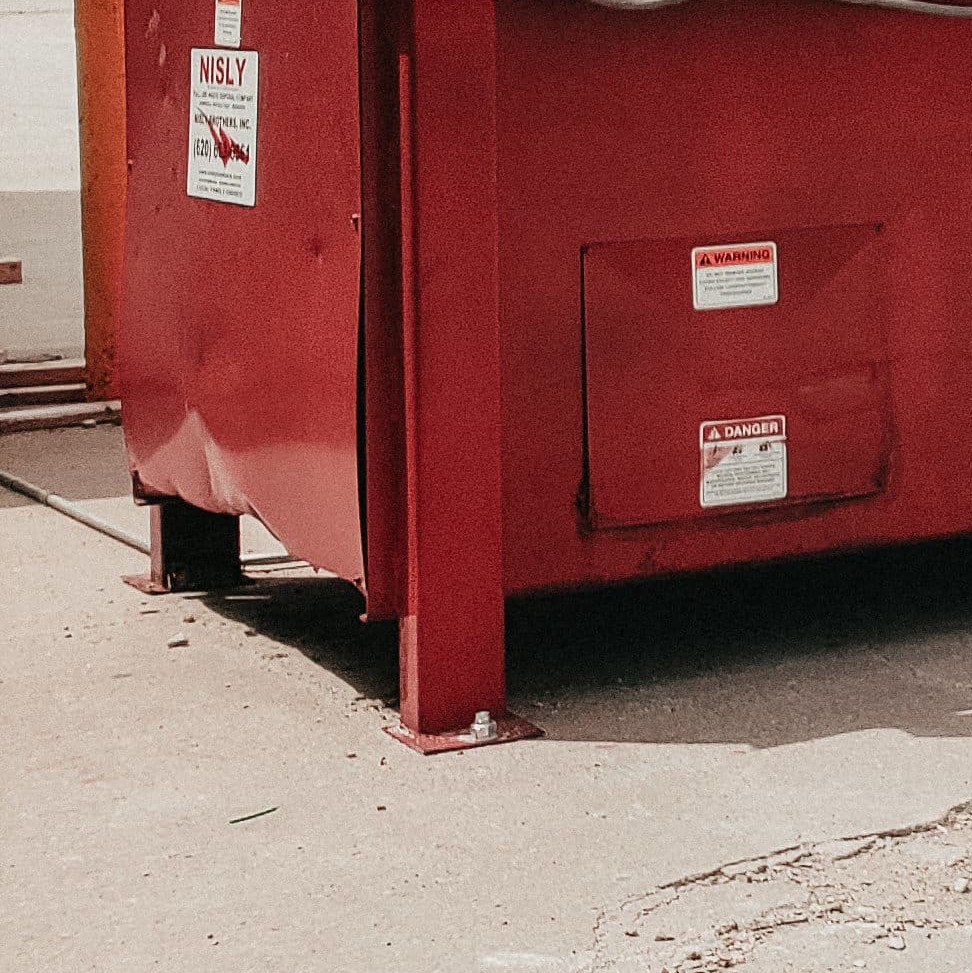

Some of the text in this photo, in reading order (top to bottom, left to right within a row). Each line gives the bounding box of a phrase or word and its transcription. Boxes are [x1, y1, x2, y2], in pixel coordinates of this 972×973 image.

[199, 55, 246, 86] NISLY
[193, 138, 212, 163] (620)
[714, 249, 770, 264] WARNING
[724, 421, 779, 438] DANGER
